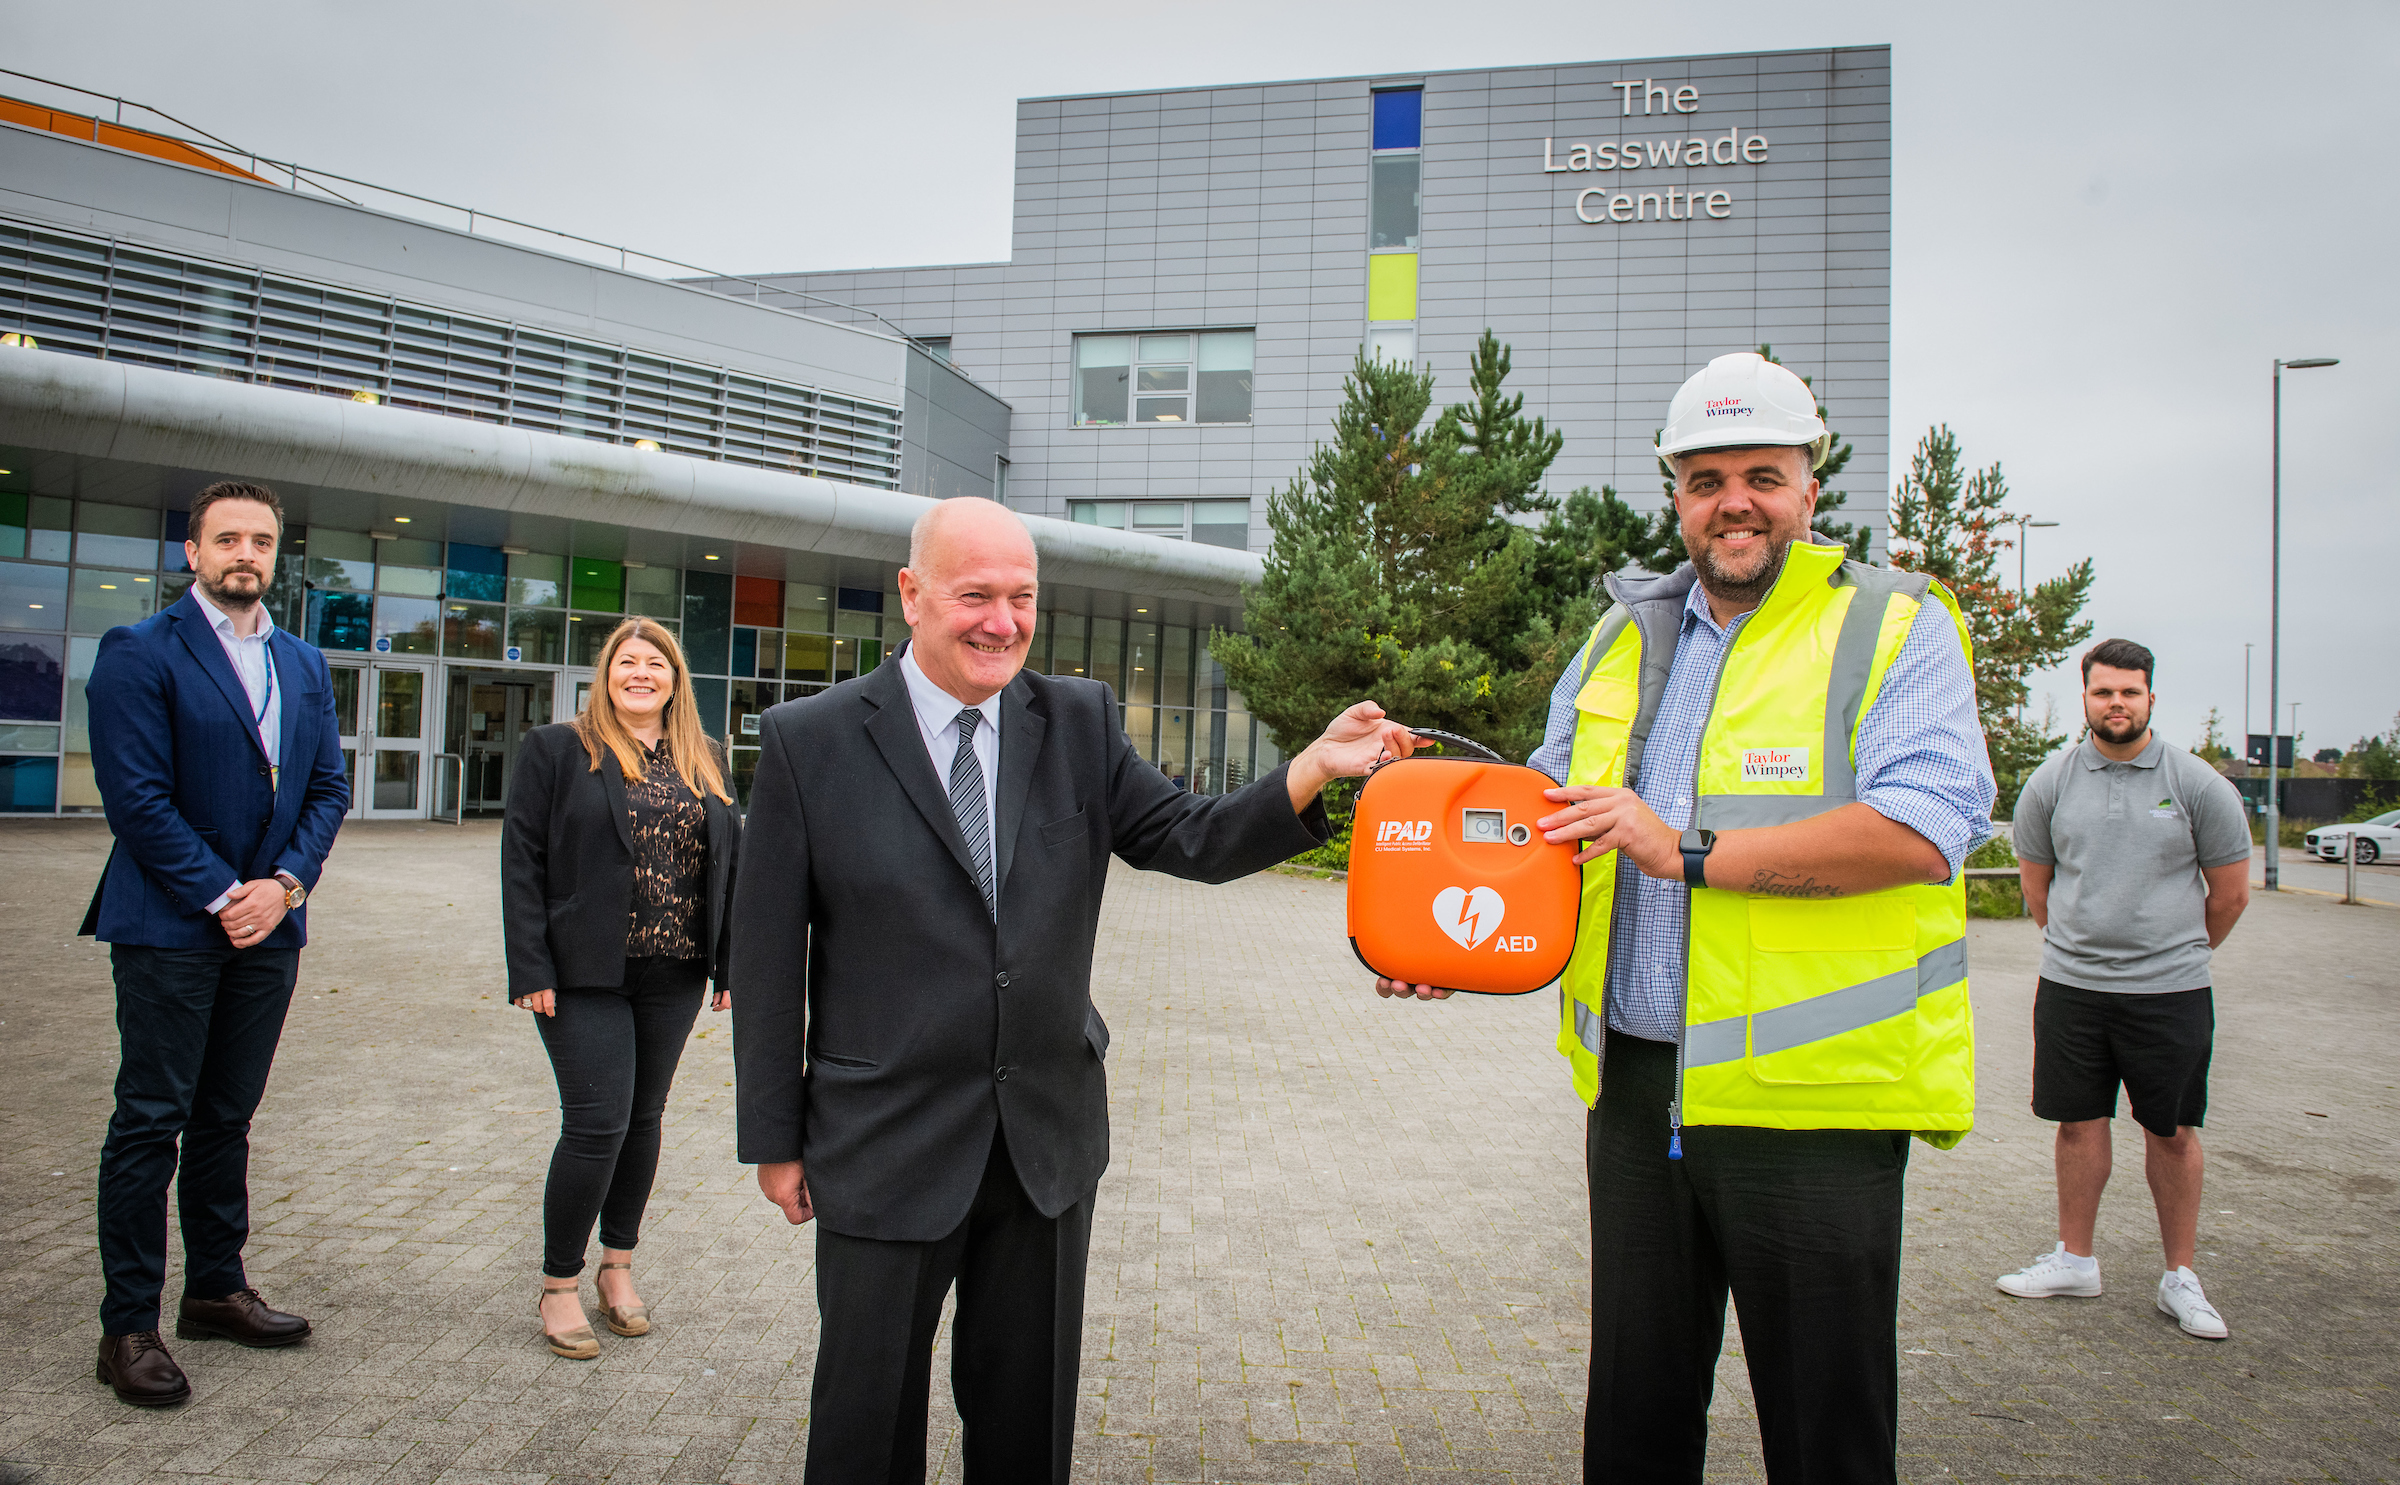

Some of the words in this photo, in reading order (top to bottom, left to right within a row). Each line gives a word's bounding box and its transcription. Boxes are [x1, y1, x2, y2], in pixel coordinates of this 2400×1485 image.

[1612, 78, 1699, 116] The
[1544, 127, 1768, 172] Lasswade
[1575, 187, 1731, 223] Centre
[1705, 397, 1741, 409] Taylor
[1706, 407, 1754, 417] Wimpey
[1745, 751, 1790, 766] Taylor
[1745, 765, 1806, 778] Wimpey
[1376, 821, 1432, 841] IPAD
[1494, 936, 1537, 952] AED
